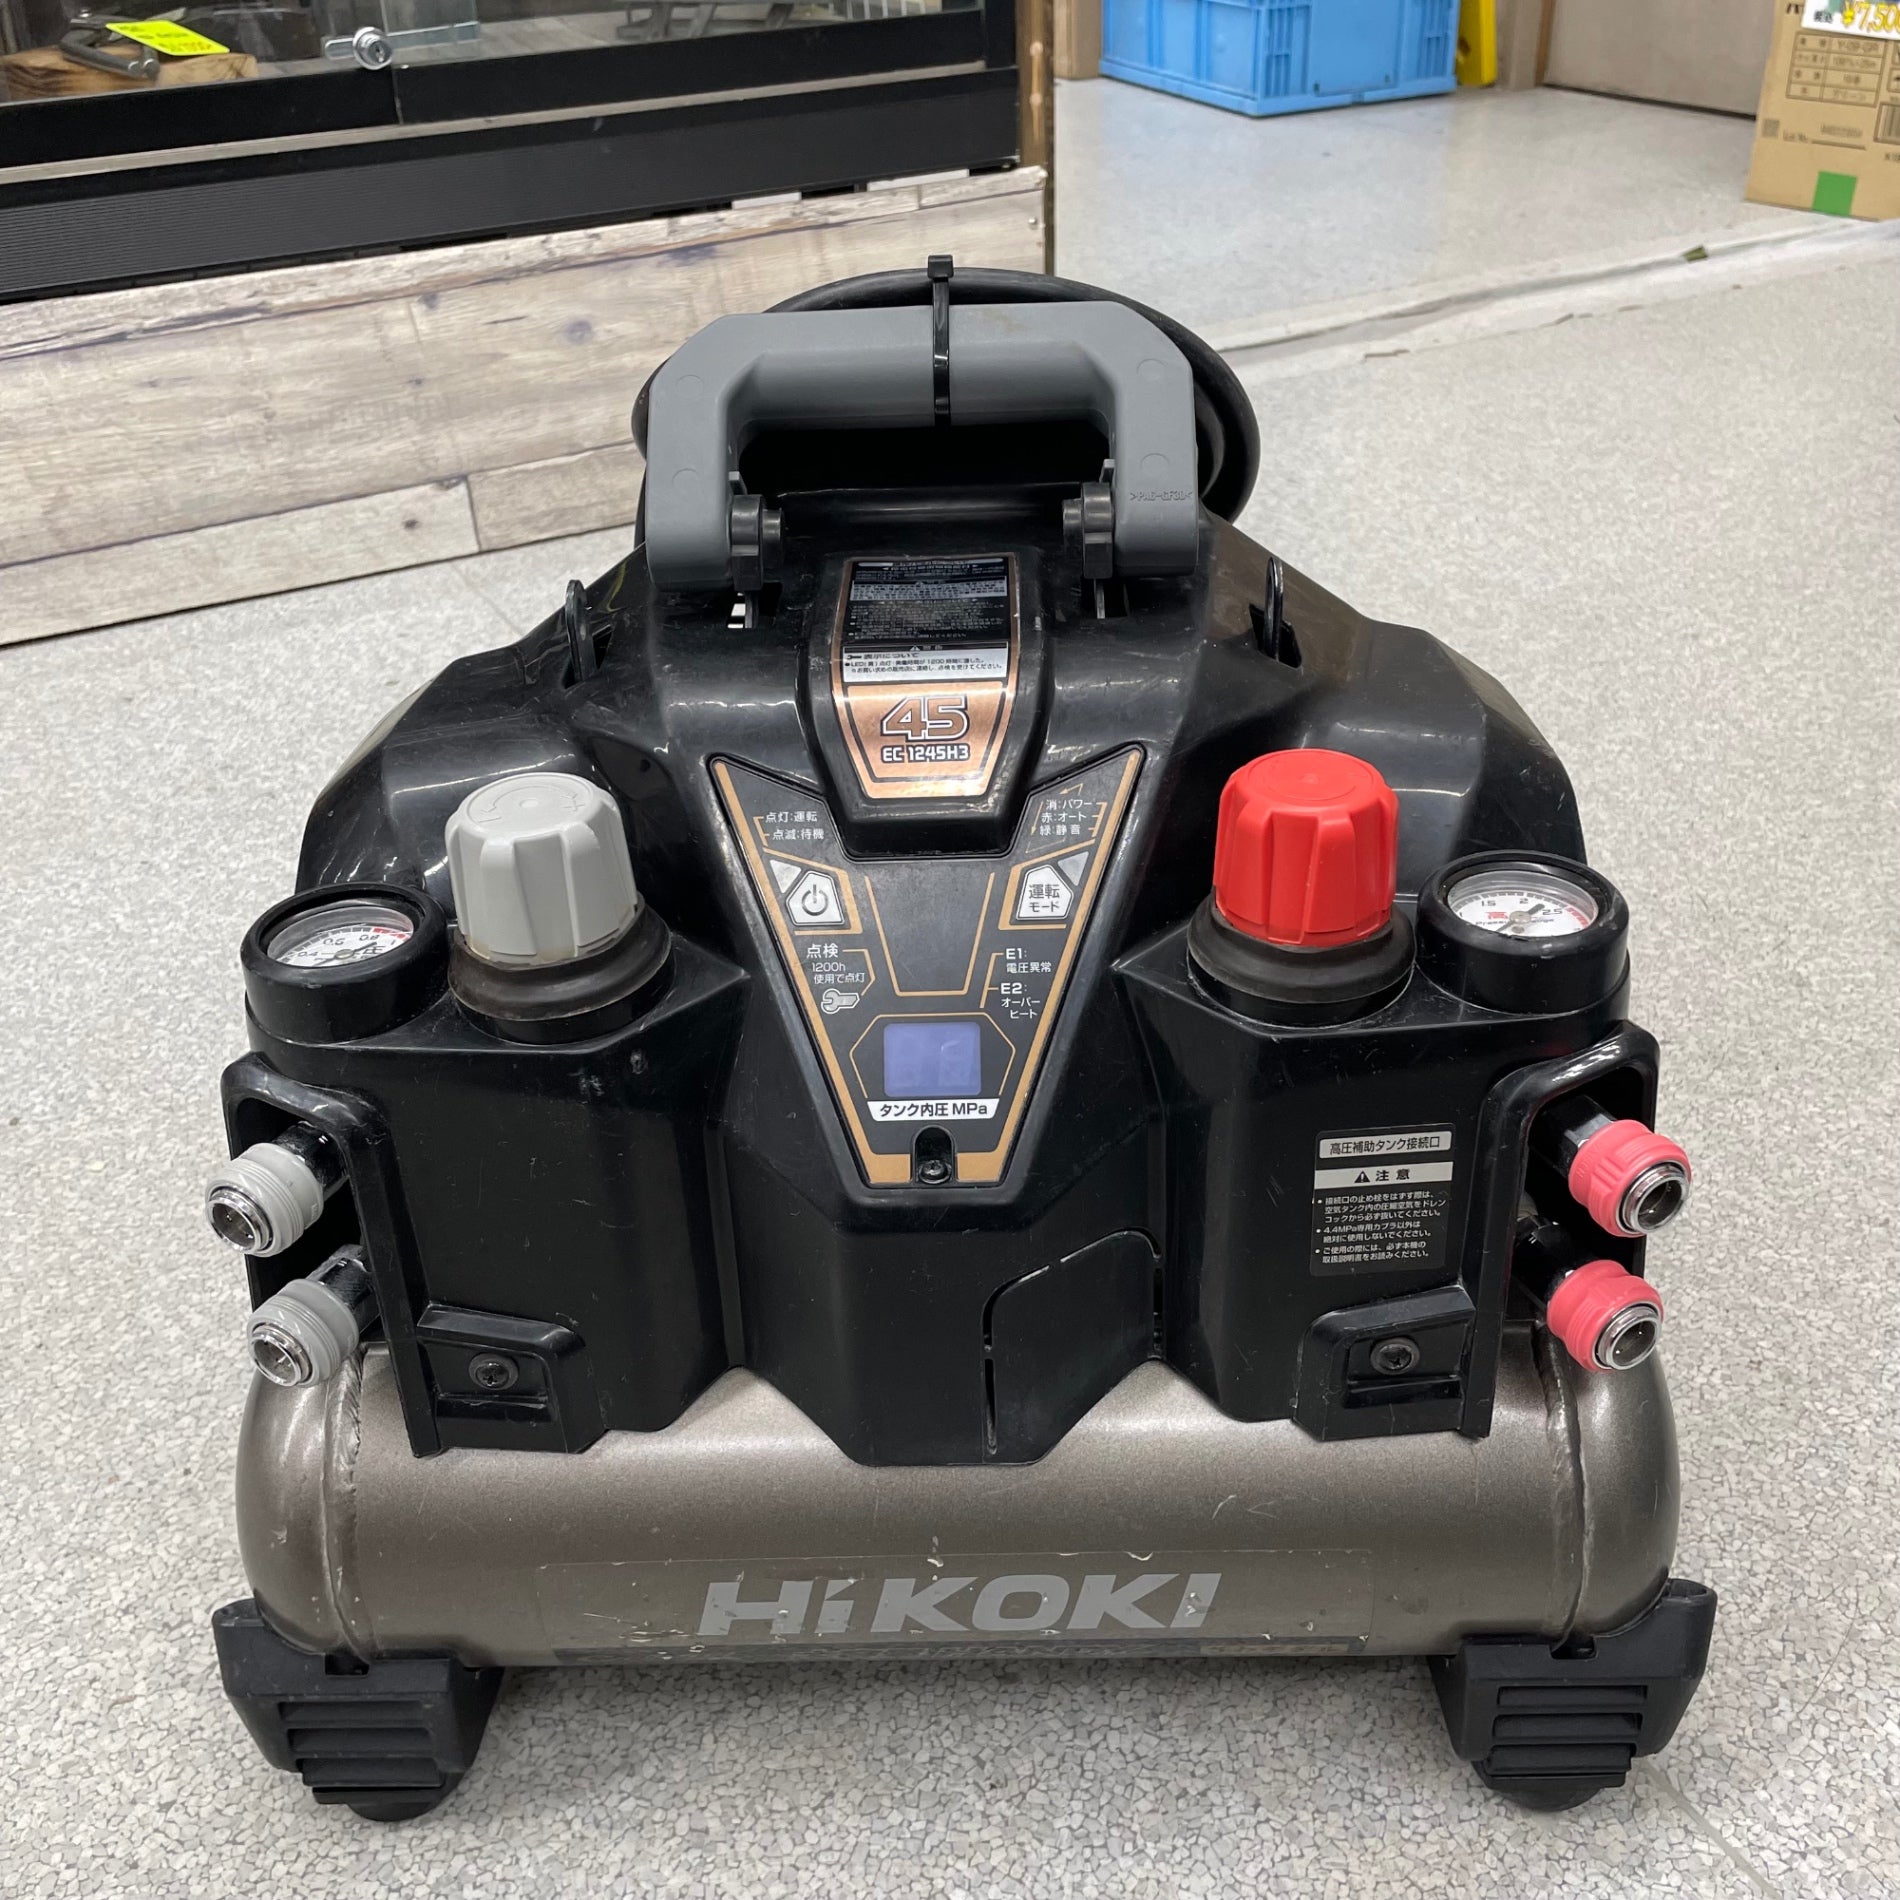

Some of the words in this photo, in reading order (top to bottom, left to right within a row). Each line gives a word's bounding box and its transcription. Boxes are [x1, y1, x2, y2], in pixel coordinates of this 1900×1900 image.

[881, 693, 970, 742] 45
[1045, 799, 1092, 811] 消:パワー
[765, 811, 818, 824] 点灯:運転
[1041, 812, 1087, 824] 赤:オート
[772, 828, 825, 841] 点滅:待機
[1028, 884, 1060, 900] 運転
[1028, 901, 1060, 913] モード
[806, 943, 839, 959] 点検
[1005, 948, 1027, 960] E1:
[811, 962, 846, 972] 1200h
[1006, 961, 1052, 973] 電圧異常
[813, 972, 865, 984] 使用で点灯
[1000, 982, 1027, 994] E2:
[1000, 997, 1041, 1008] オーバー
[1009, 1009, 1038, 1020] ヒート
[880, 1103, 948, 1117] タンク内圧
[952, 1103, 988, 1115] MPa
[1329, 1136, 1440, 1155] 高圧補助タンク接続口
[1375, 1169, 1410, 1182] 注意
[694, 1573, 1222, 1637] HiKOKI
